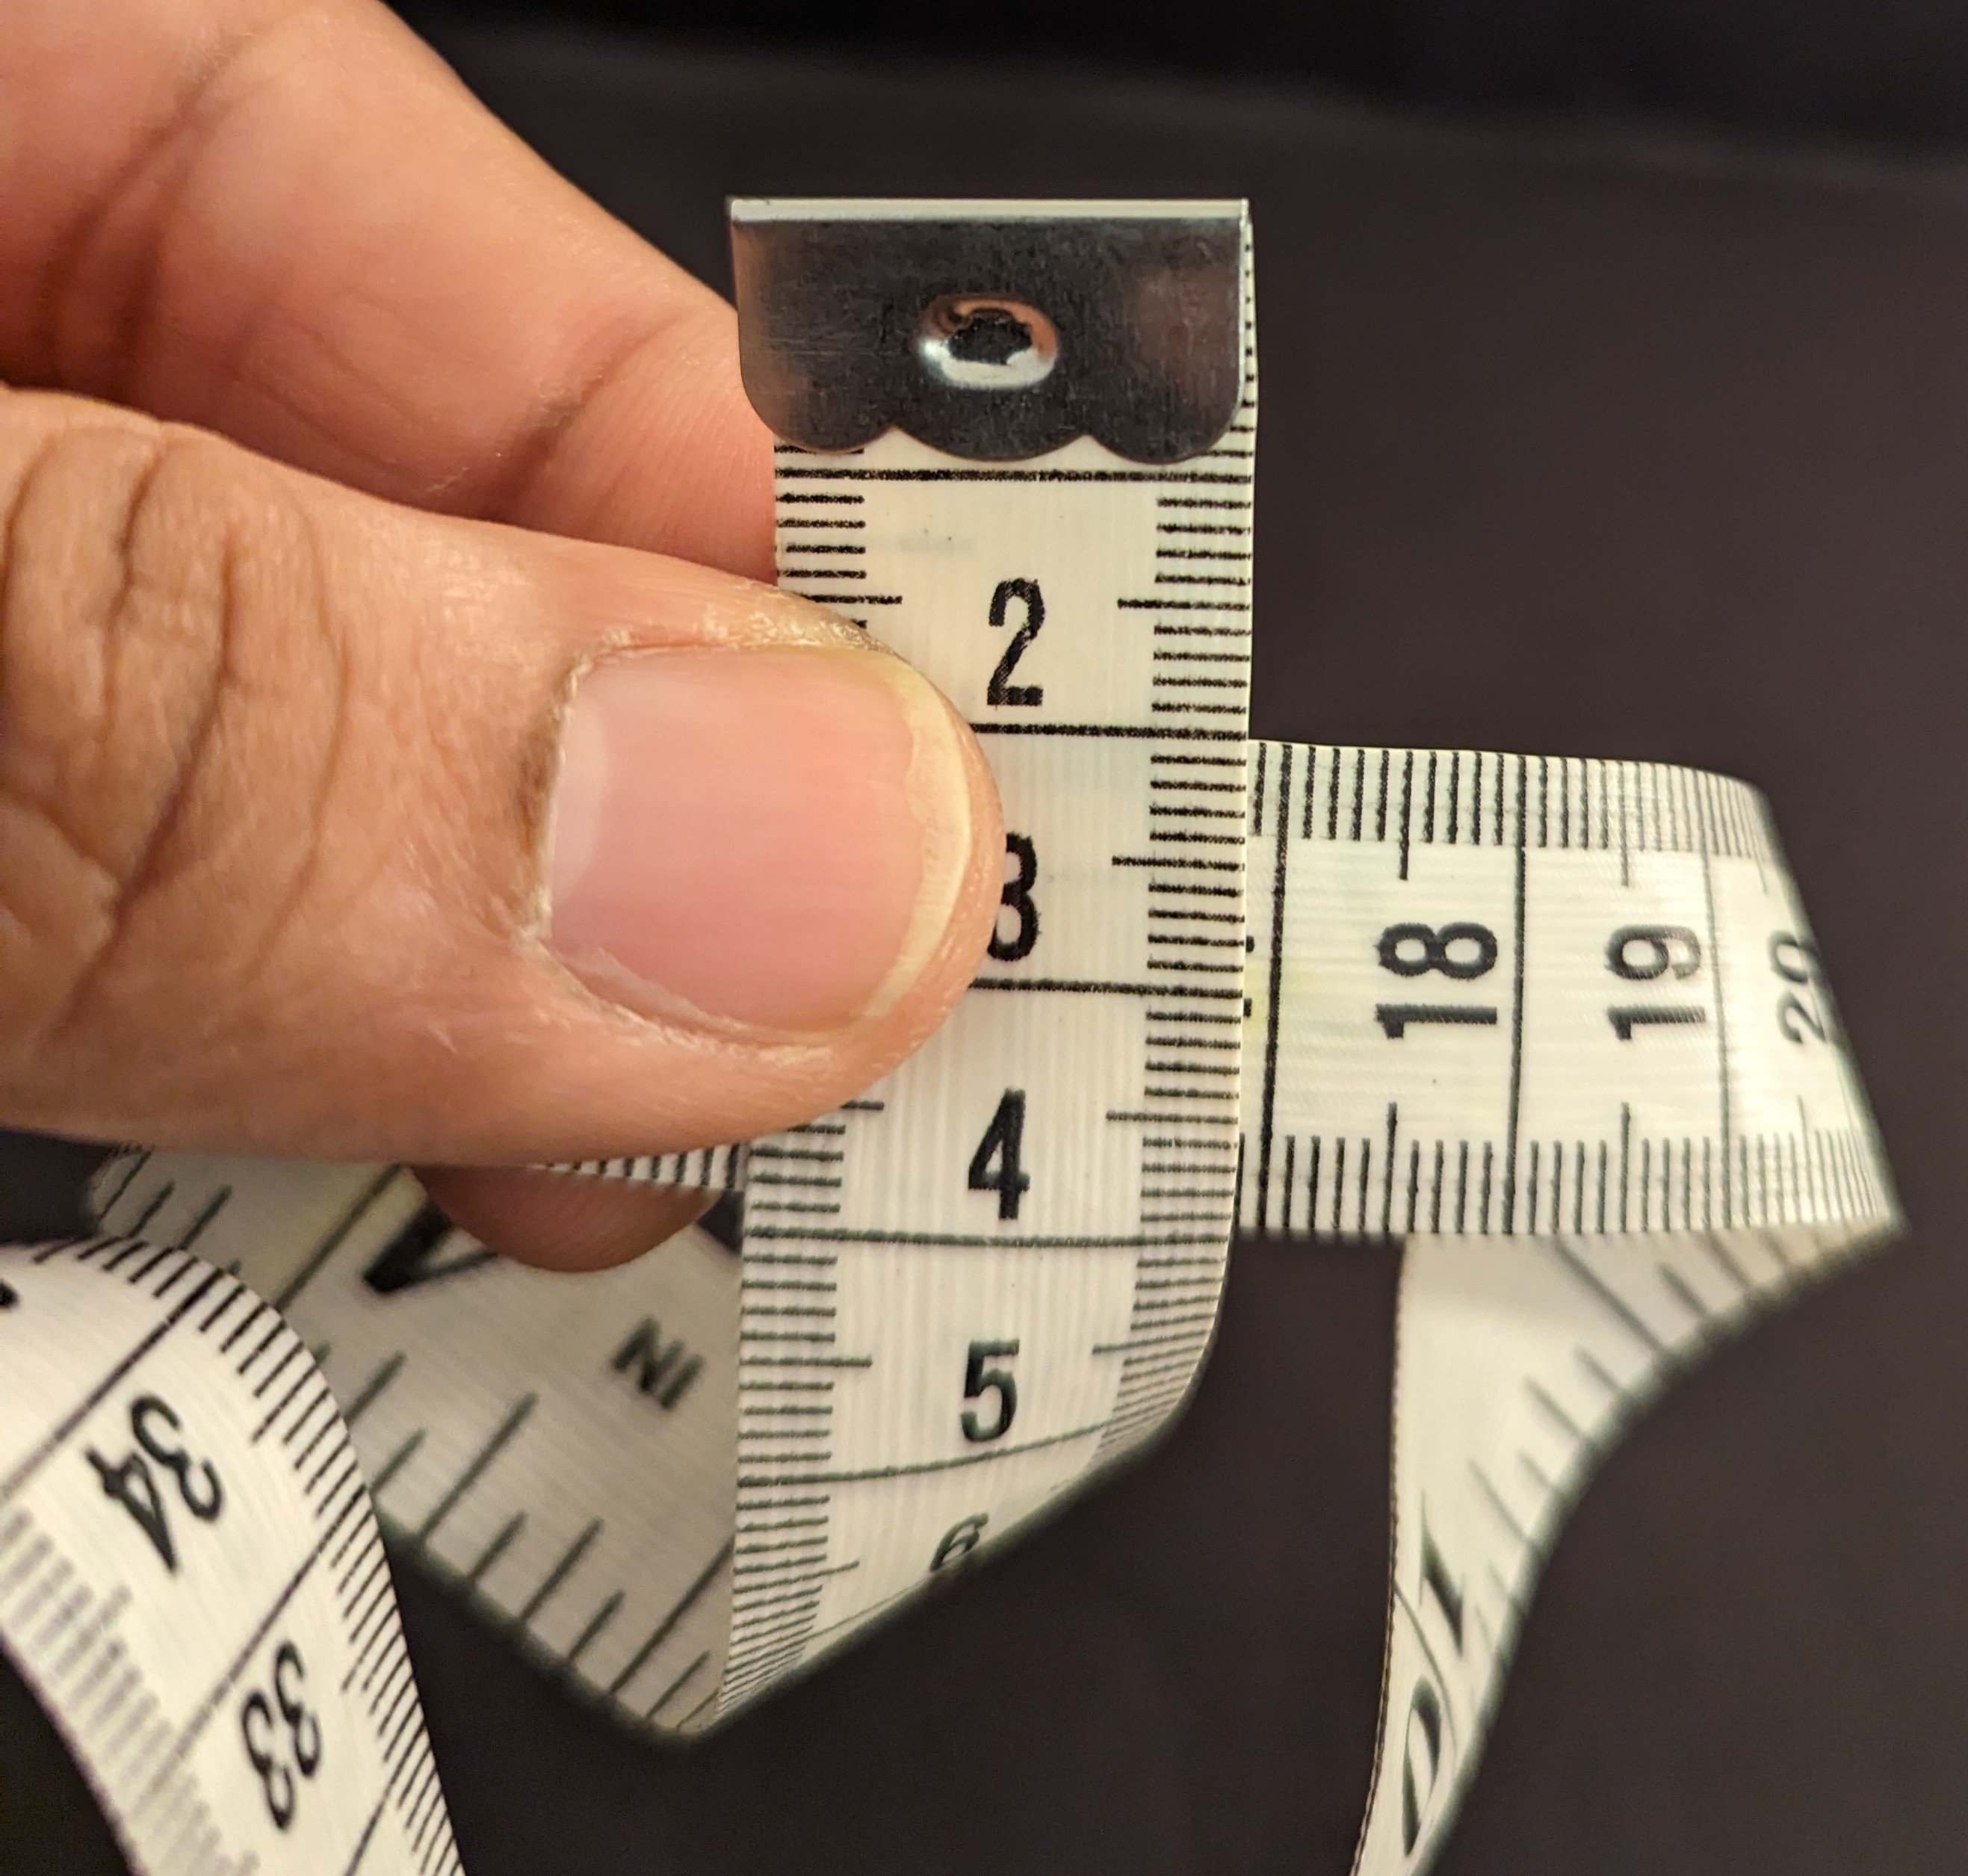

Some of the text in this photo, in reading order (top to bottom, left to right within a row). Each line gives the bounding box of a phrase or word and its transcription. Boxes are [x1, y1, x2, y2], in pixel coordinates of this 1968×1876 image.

[987, 578, 1046, 706] 2
[987, 832, 1041, 962] 3
[1375, 921, 1498, 1040] 18
[1605, 923, 1706, 1041] 19
[1768, 930, 1828, 1044] 20
[968, 1088, 1030, 1219] 4
[960, 1340, 1019, 1443] 5
[85, 1394, 223, 1574] 34
[241, 1640, 321, 1831] 33
